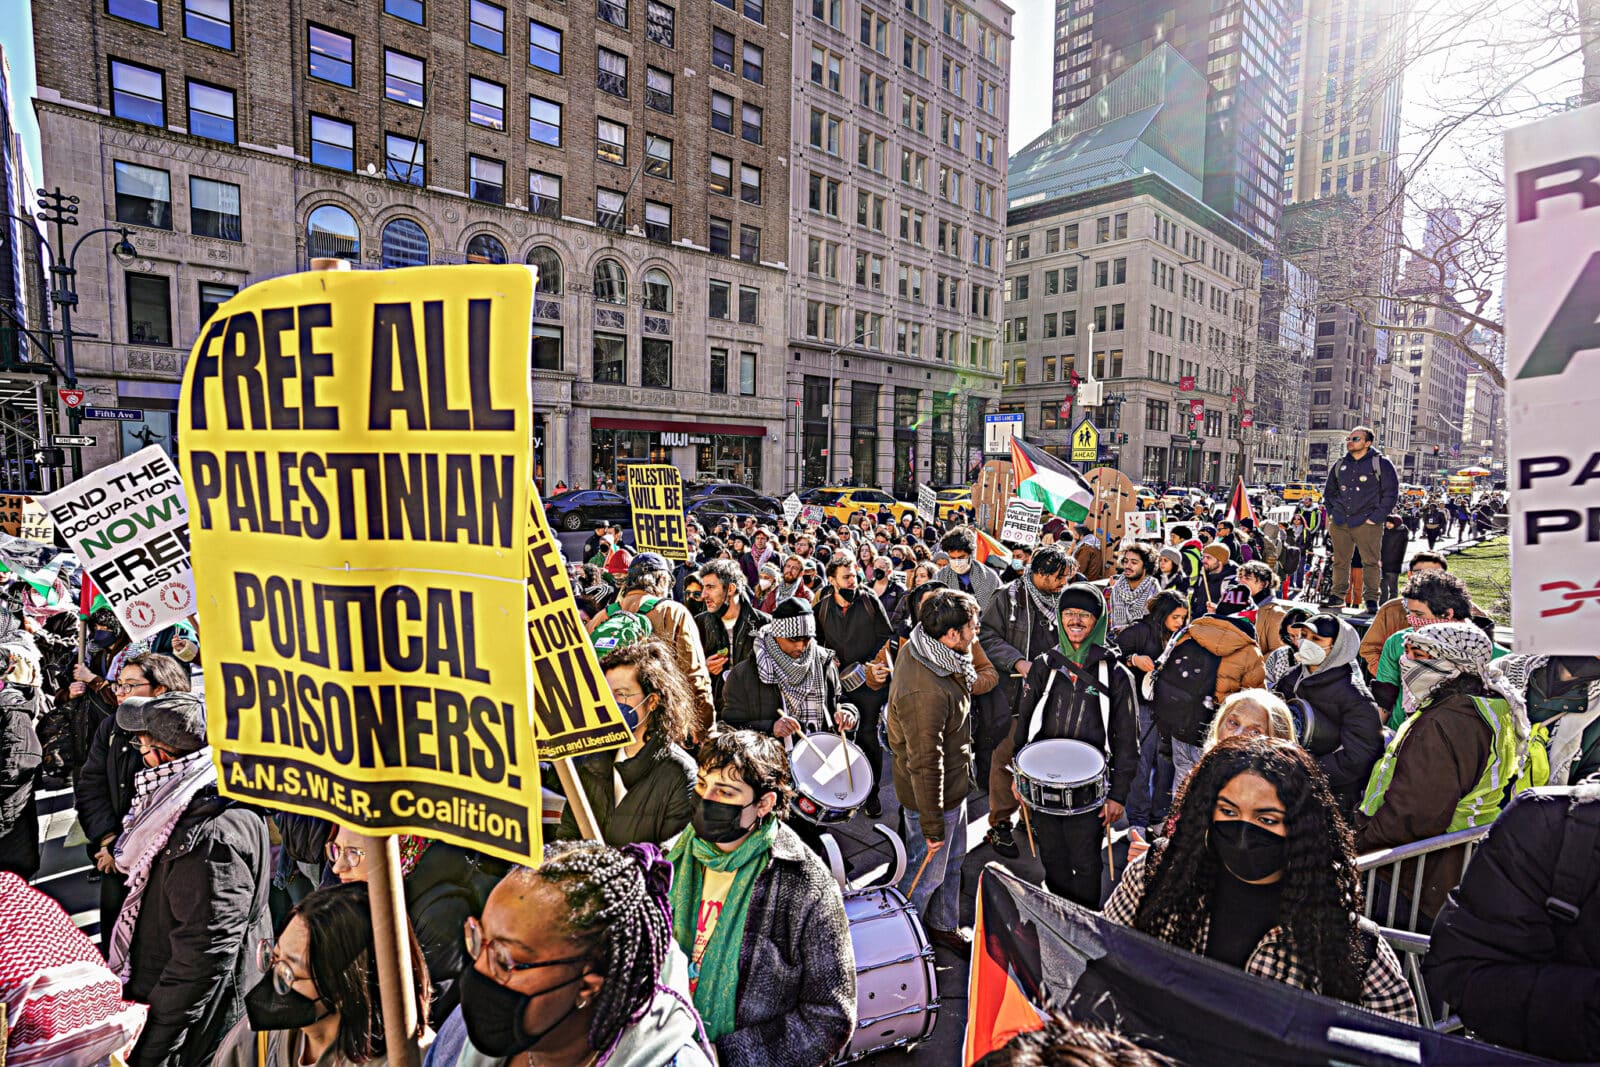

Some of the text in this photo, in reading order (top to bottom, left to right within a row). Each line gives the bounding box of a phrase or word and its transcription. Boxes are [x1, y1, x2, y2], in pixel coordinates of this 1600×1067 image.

[190, 298, 515, 431] FREE ALL
[94, 410, 134, 419] Fifth Ave
[661, 432, 688, 447] MUJI
[50, 457, 171, 525] END THE
[62, 475, 181, 539] OCCUPATION
[190, 450, 515, 549] PALESTINIAN
[629, 467, 680, 486] PALESTINE
[631, 486, 681, 510] WILL BE
[79, 494, 186, 559] NOW!
[635, 513, 685, 548] FREE!
[1007, 514, 1039, 525] WILL BE
[108, 555, 192, 607] PALESTI
[234, 571, 491, 685] POLITICAL
[533, 646, 613, 738] W!
[219, 662, 522, 790] PRISONERS!
[566, 738, 583, 751] and
[582, 731, 629, 748] Liberation
[230, 761, 522, 843] A.N.S.W.E.R. Coalition
